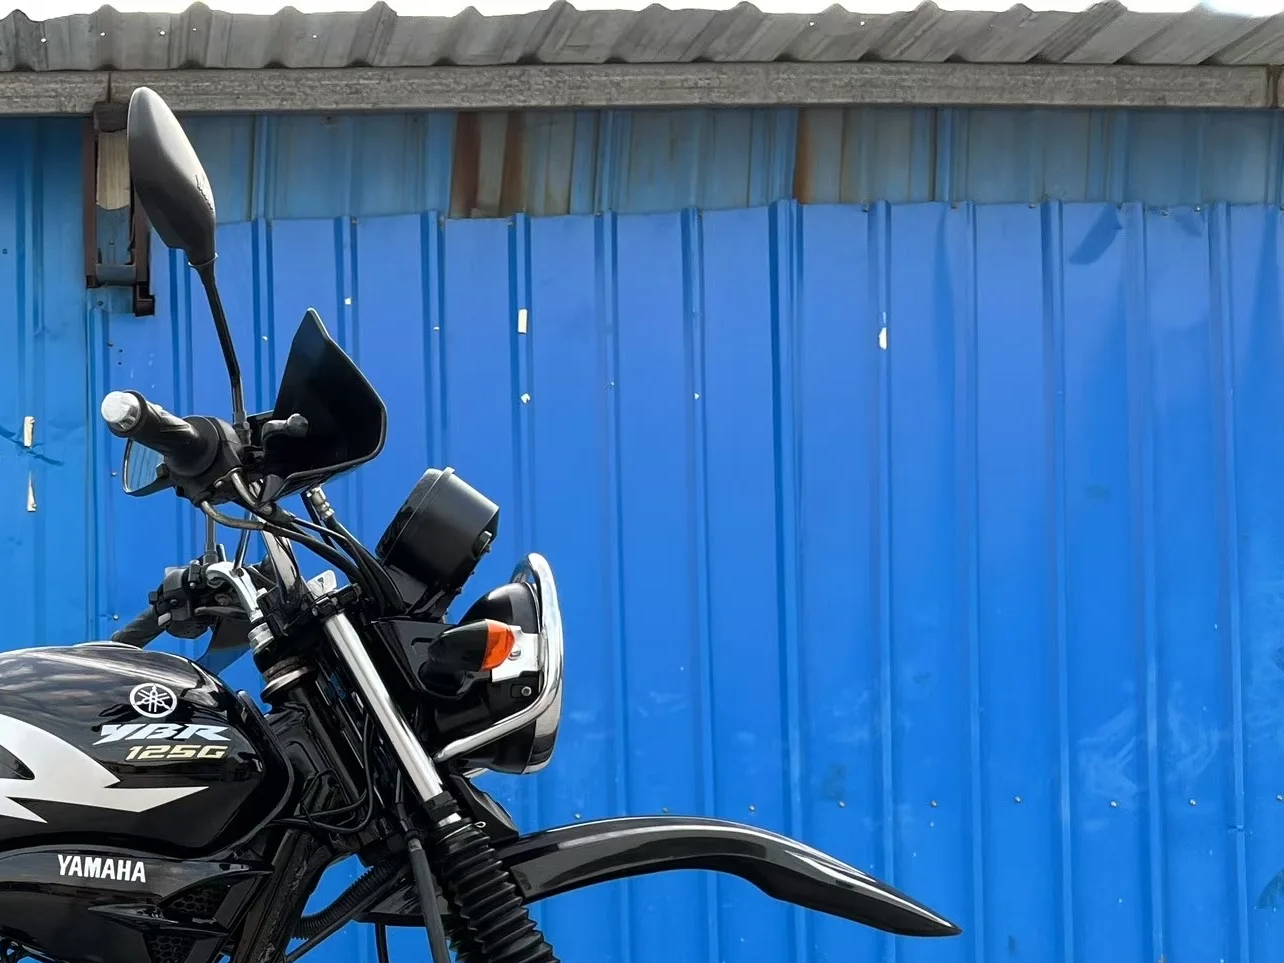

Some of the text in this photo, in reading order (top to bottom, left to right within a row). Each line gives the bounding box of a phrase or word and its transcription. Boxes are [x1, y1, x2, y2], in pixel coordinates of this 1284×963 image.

[92, 723, 231, 746] YBR
[125, 744, 229, 760] 125G
[57, 854, 146, 883] YAMAHA
